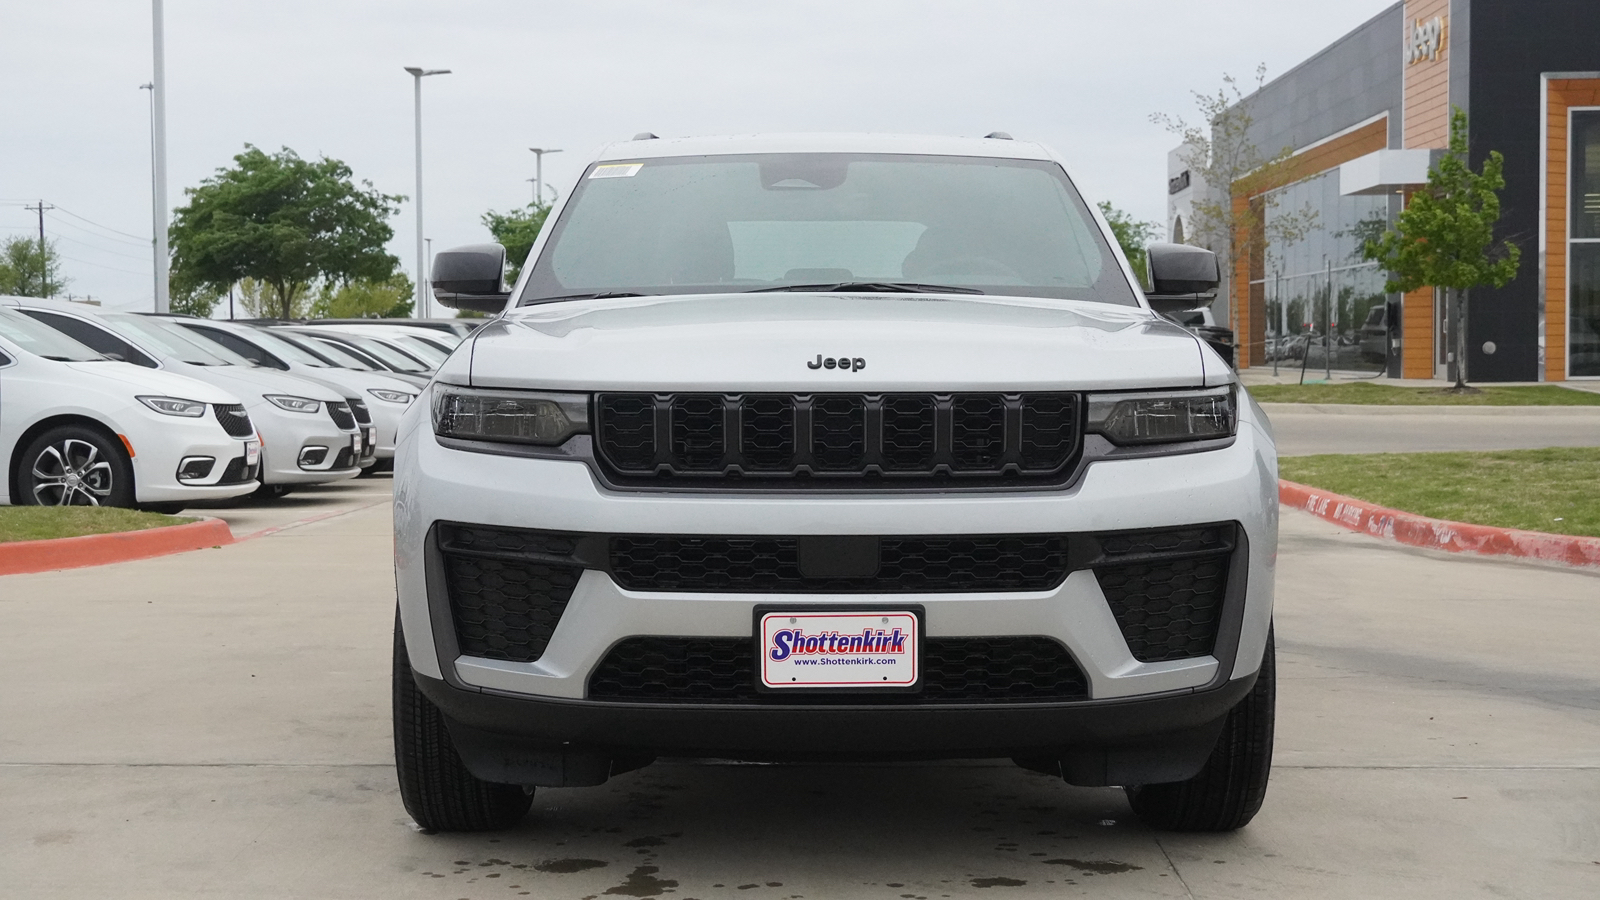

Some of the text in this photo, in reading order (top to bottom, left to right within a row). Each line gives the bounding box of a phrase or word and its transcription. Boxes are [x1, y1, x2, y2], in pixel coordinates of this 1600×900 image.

[1404, 16, 1440, 62] Jeep
[807, 354, 866, 372] Jeep
[770, 628, 908, 662] Shottenkirk
[794, 657, 896, 666] www.Shottenkirk.com
